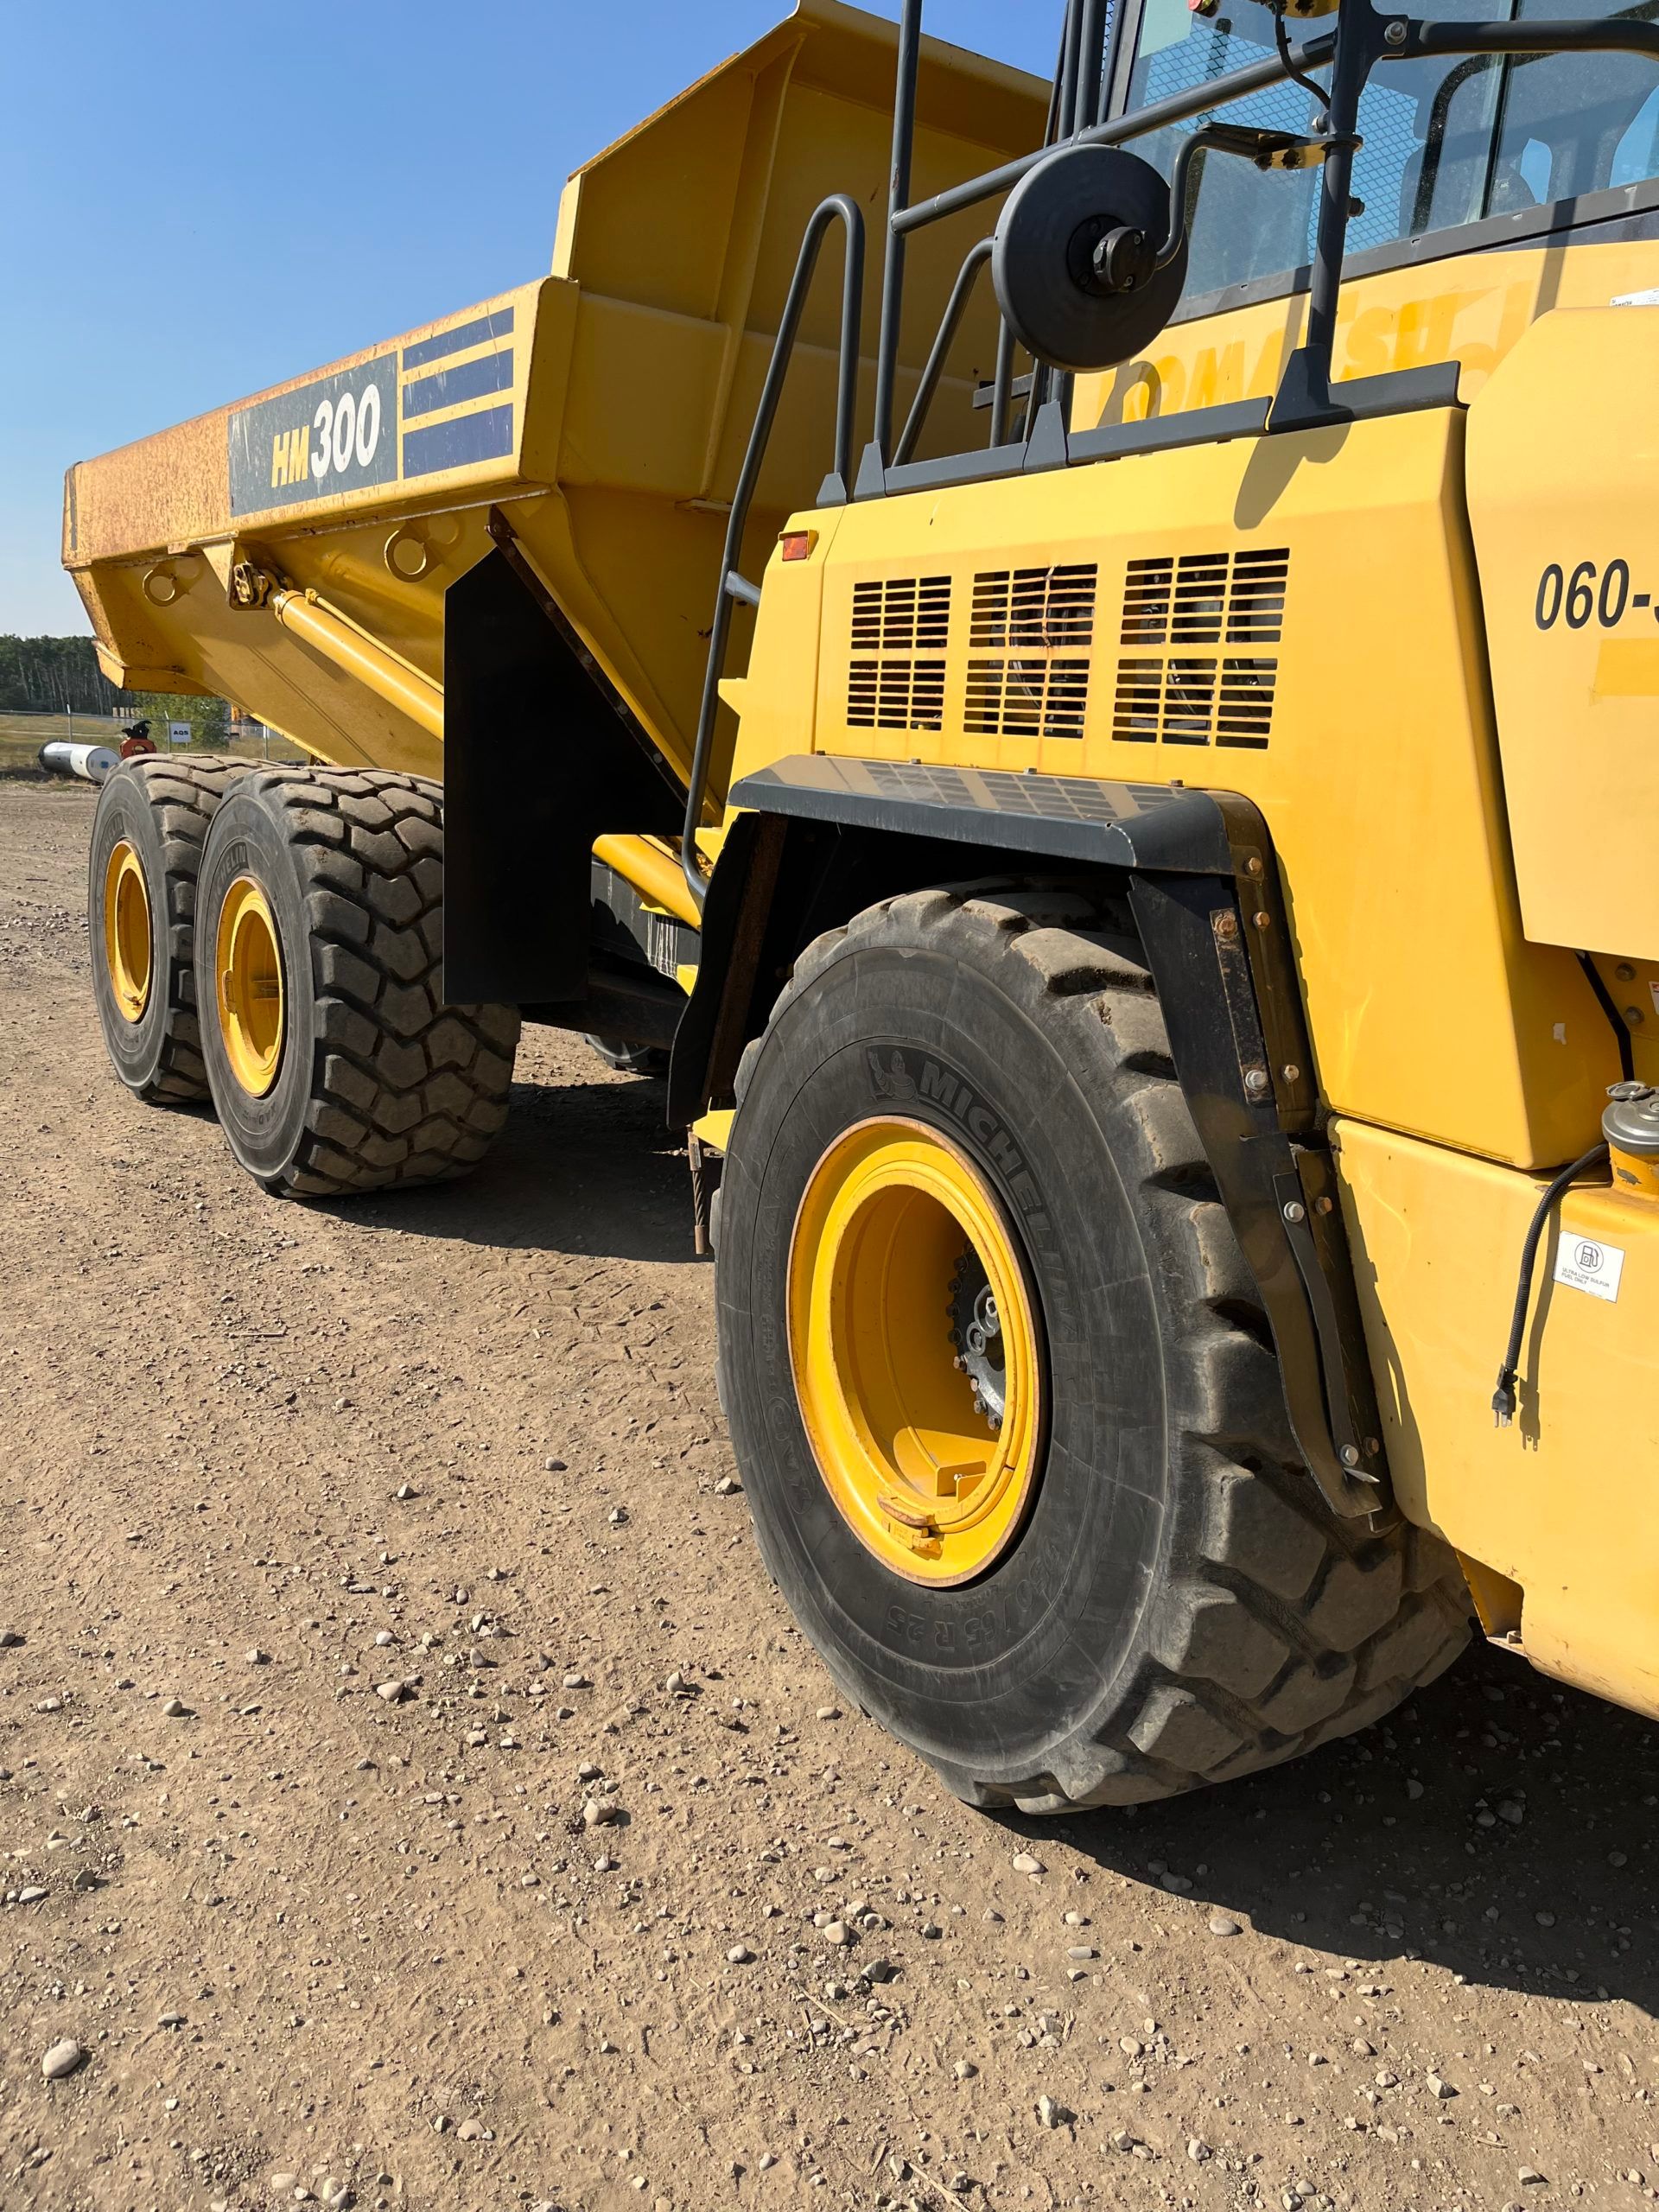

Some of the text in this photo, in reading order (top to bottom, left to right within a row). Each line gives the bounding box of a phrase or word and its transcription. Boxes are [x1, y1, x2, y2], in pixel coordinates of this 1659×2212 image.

[1535, 558, 1659, 630] 060-
[1562, 1267, 1578, 1276] ULTRA
[1561, 1272, 1587, 1285] FUEL ONLY
